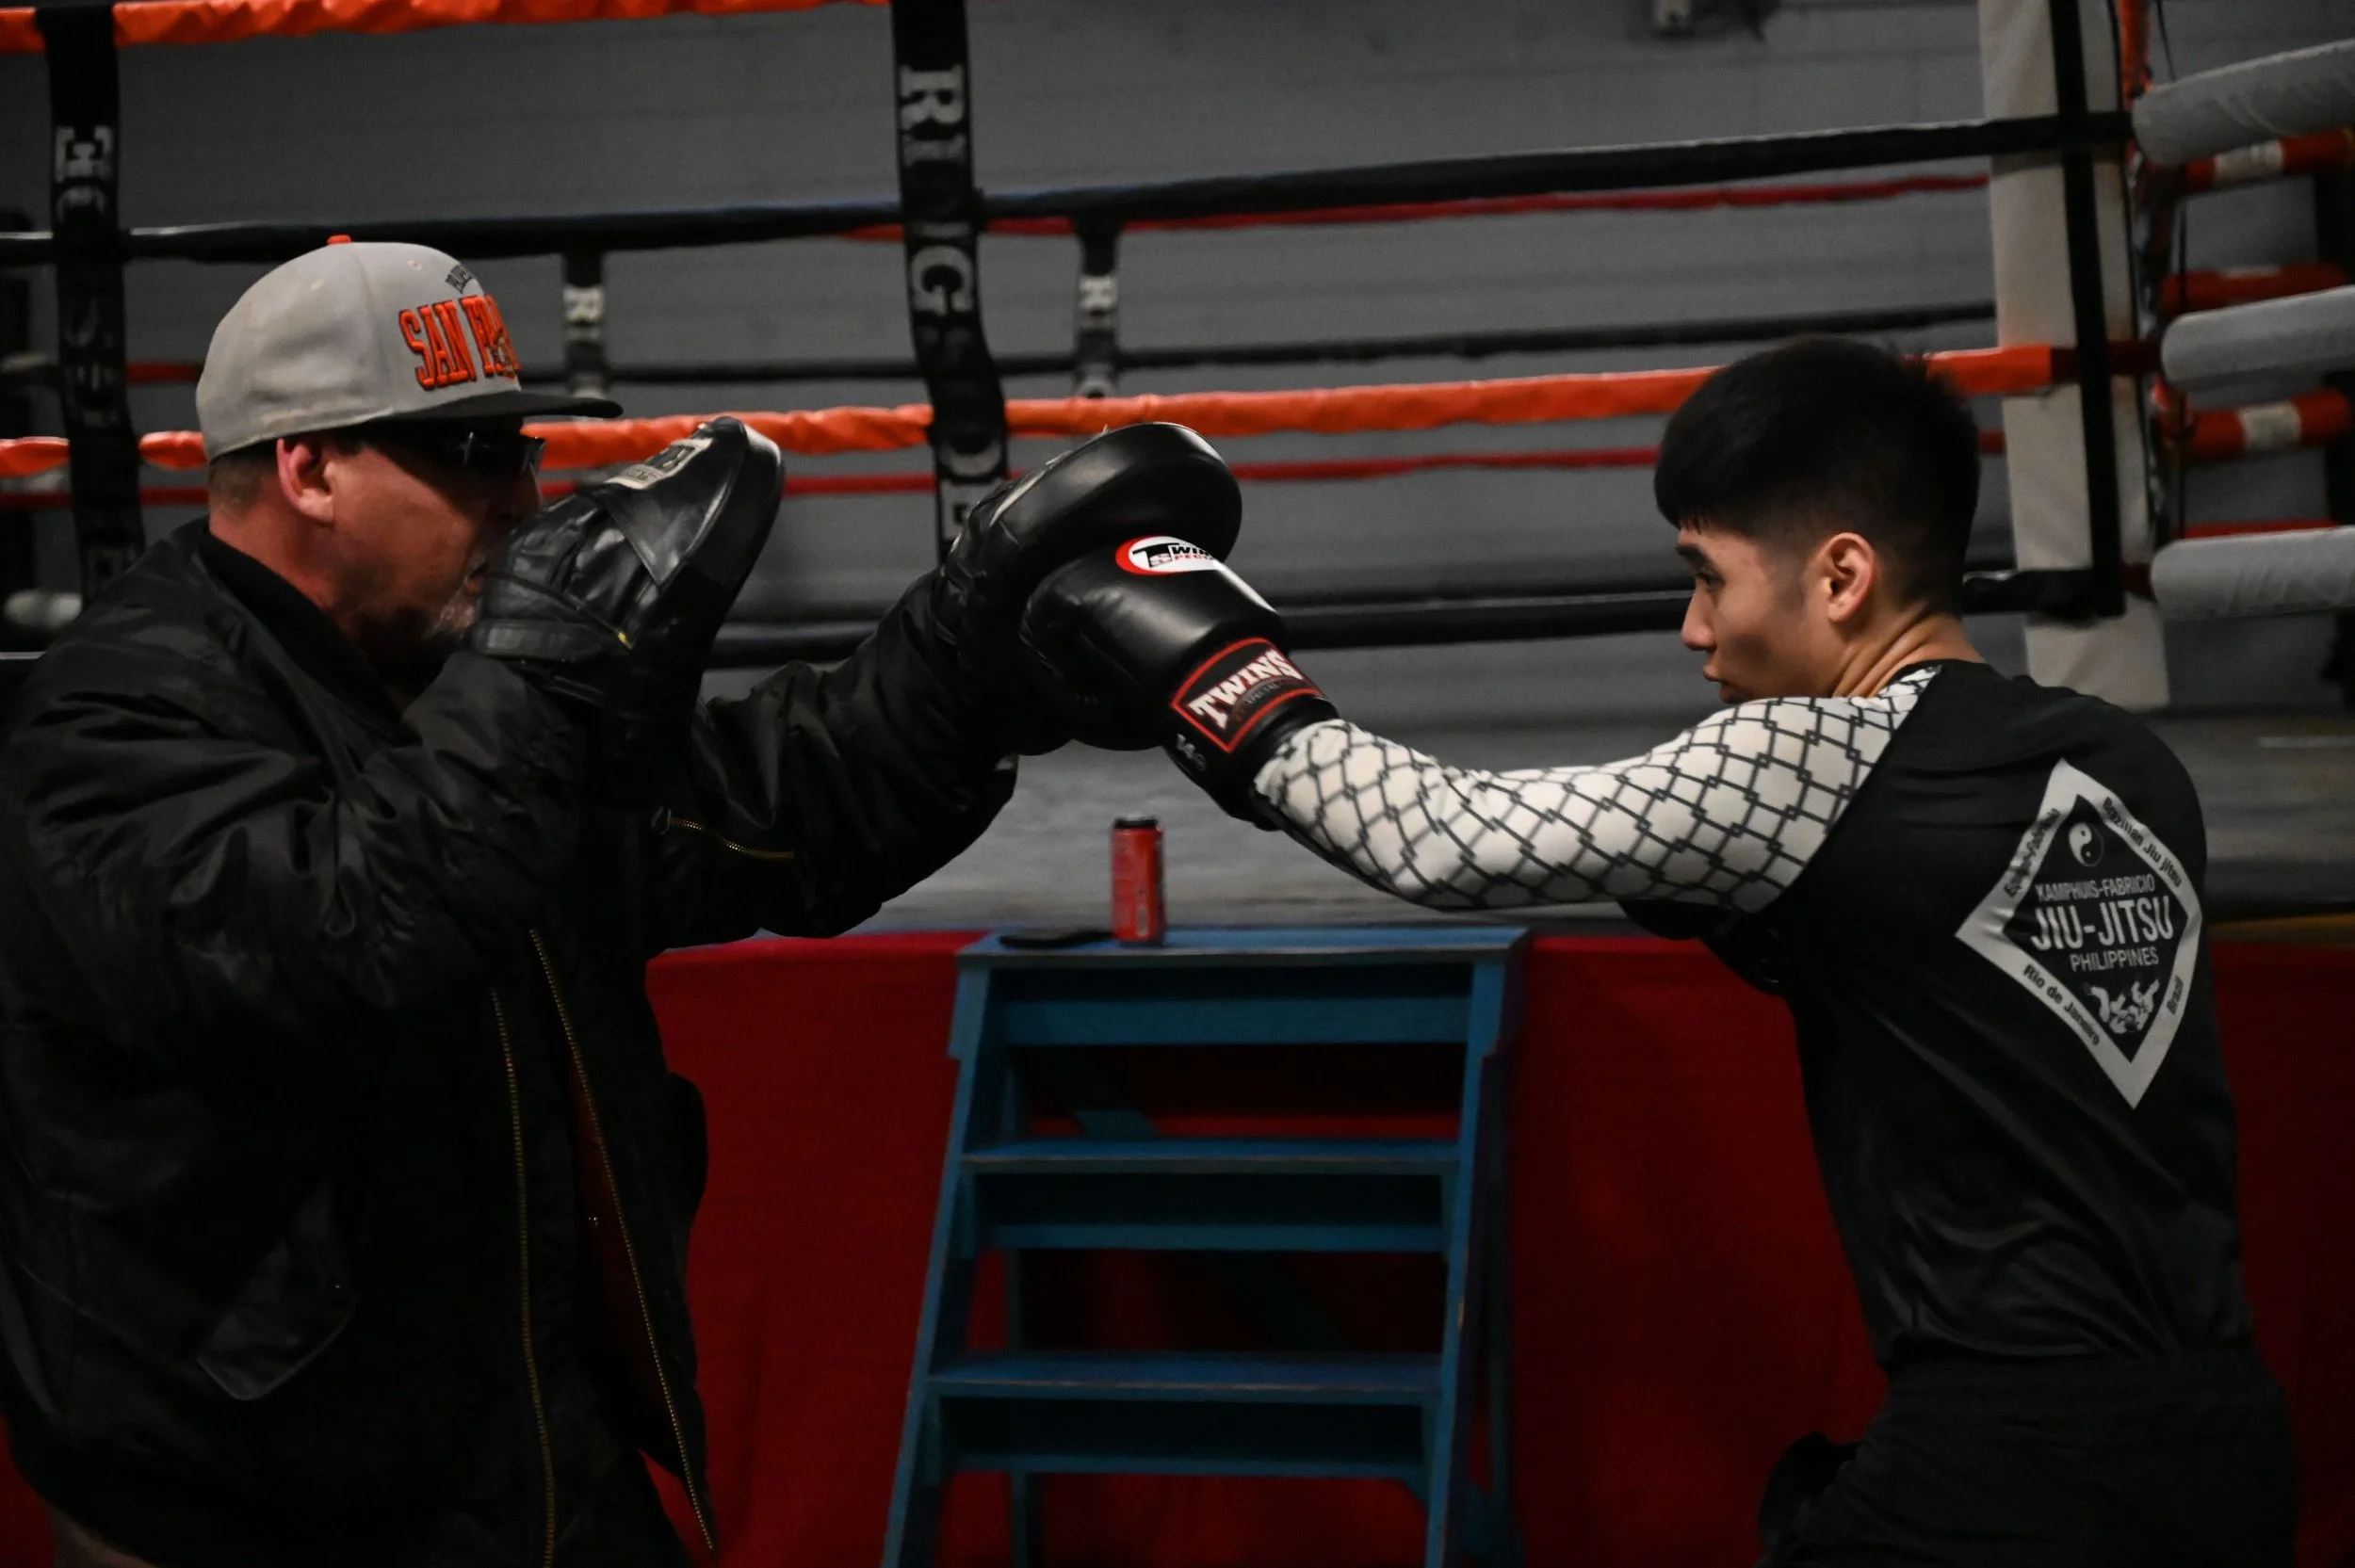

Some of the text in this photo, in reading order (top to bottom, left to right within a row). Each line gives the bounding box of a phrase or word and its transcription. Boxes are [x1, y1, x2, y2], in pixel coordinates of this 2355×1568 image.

[398, 299, 477, 392] SAN
[1187, 649, 1305, 730] TWINS
[2030, 895, 2174, 951] JIU-JITSU
[2023, 963, 2046, 989] Rio
[2046, 985, 2063, 1004] de
[2070, 946, 2159, 972] PHILIPPINES
